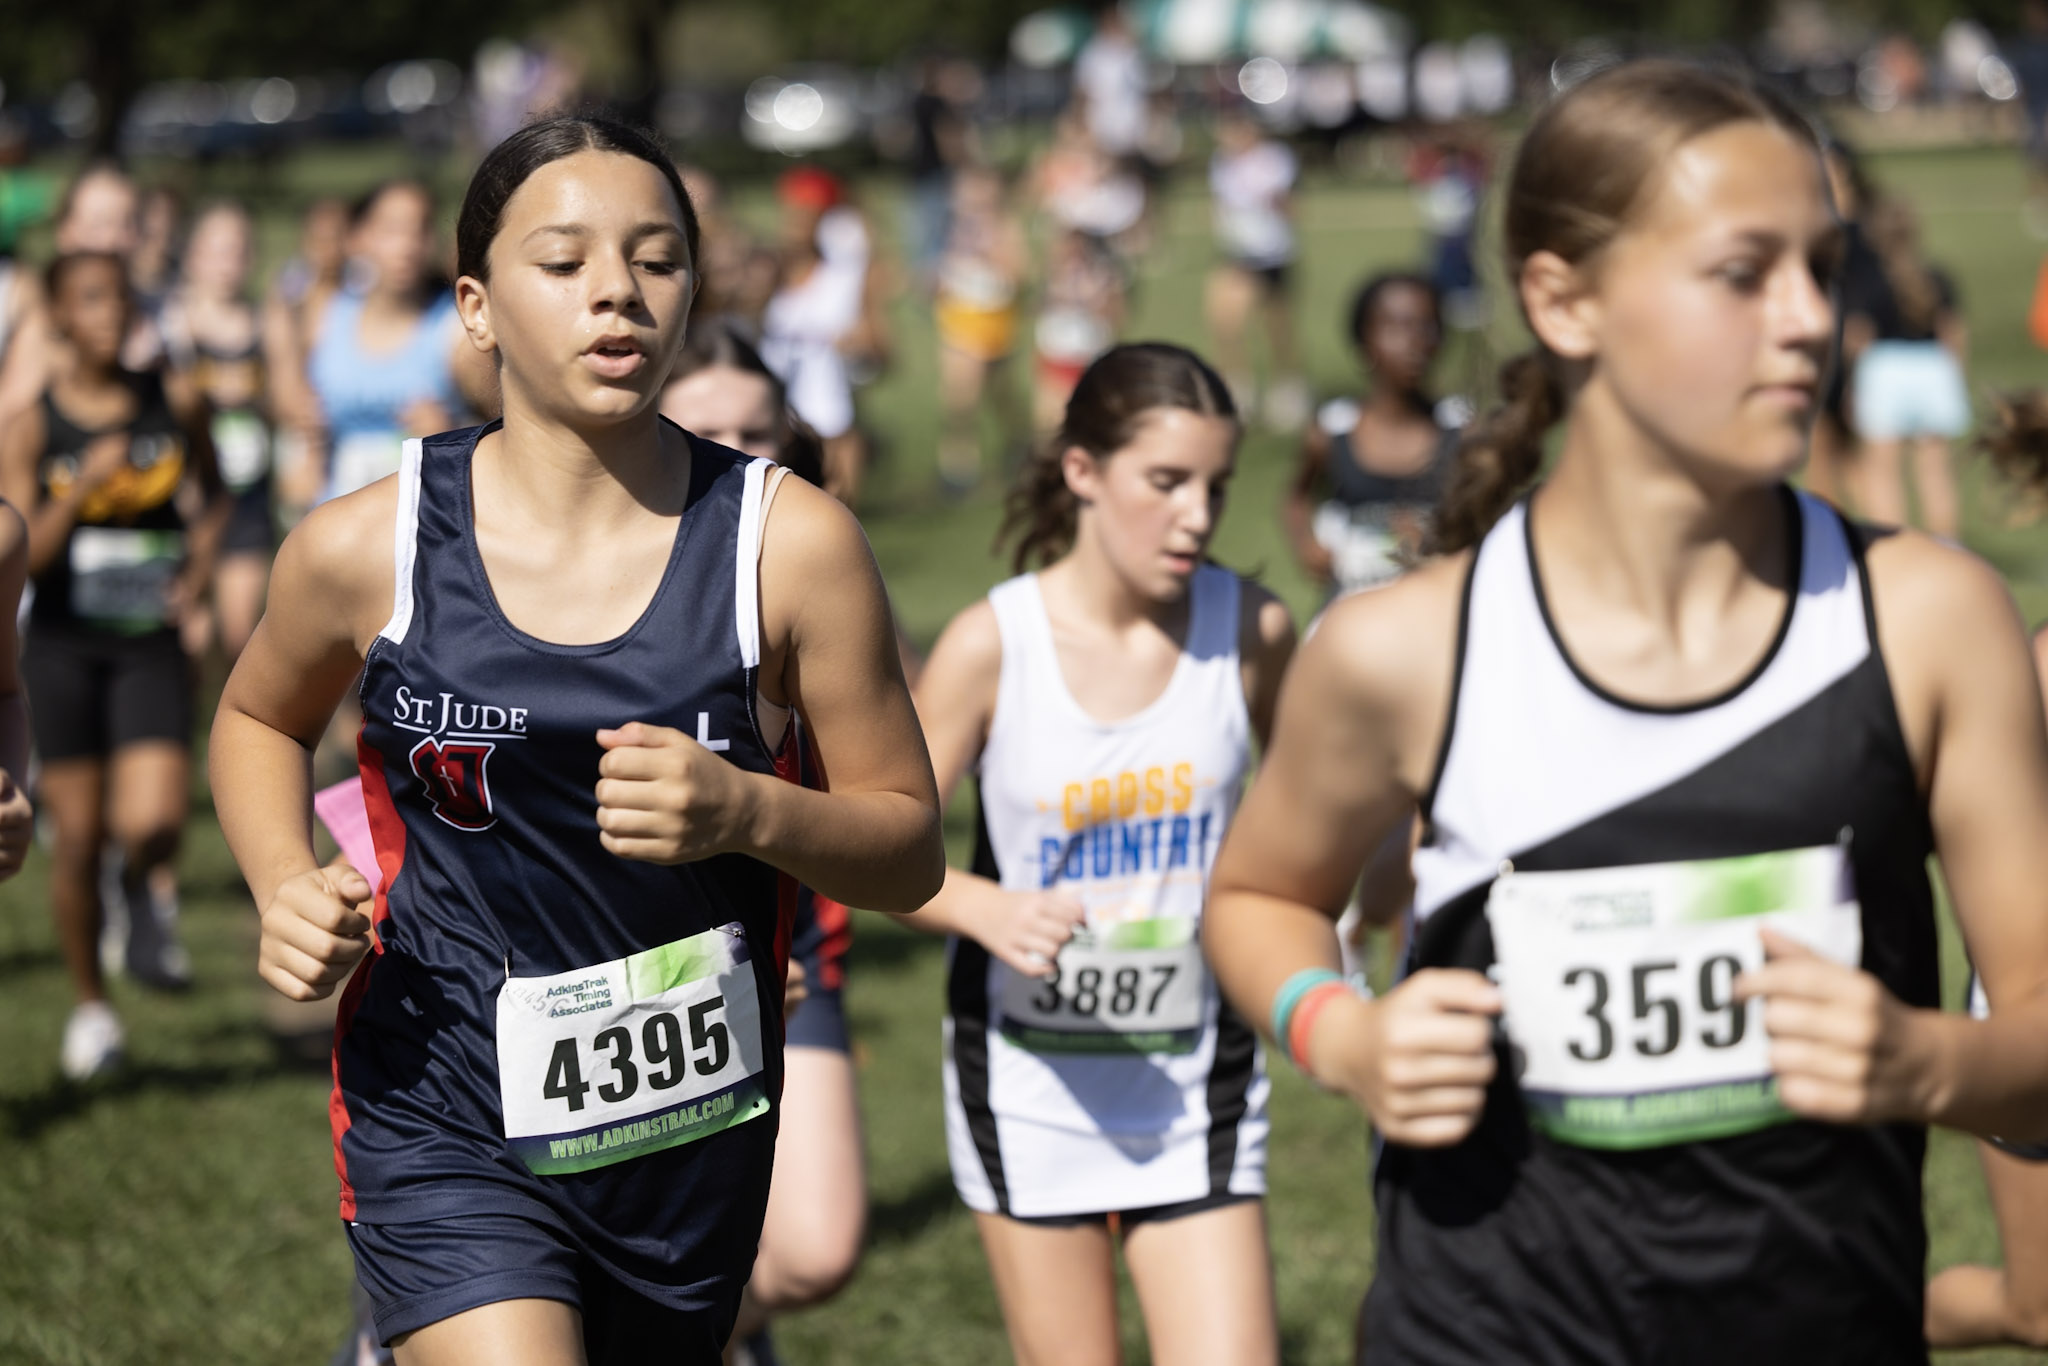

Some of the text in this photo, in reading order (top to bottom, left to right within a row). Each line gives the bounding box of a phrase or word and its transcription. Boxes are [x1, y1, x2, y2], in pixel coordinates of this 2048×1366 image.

[697, 711, 730, 752] L
[1063, 762, 1193, 832] CROSS
[550, 998, 613, 1018] Associates
[573, 988, 611, 1003] Timing
[1031, 962, 1178, 1017] 3887
[543, 995, 730, 1113] 4395
[549, 1091, 735, 1159] WWW.ADKINSTRAK.COM
